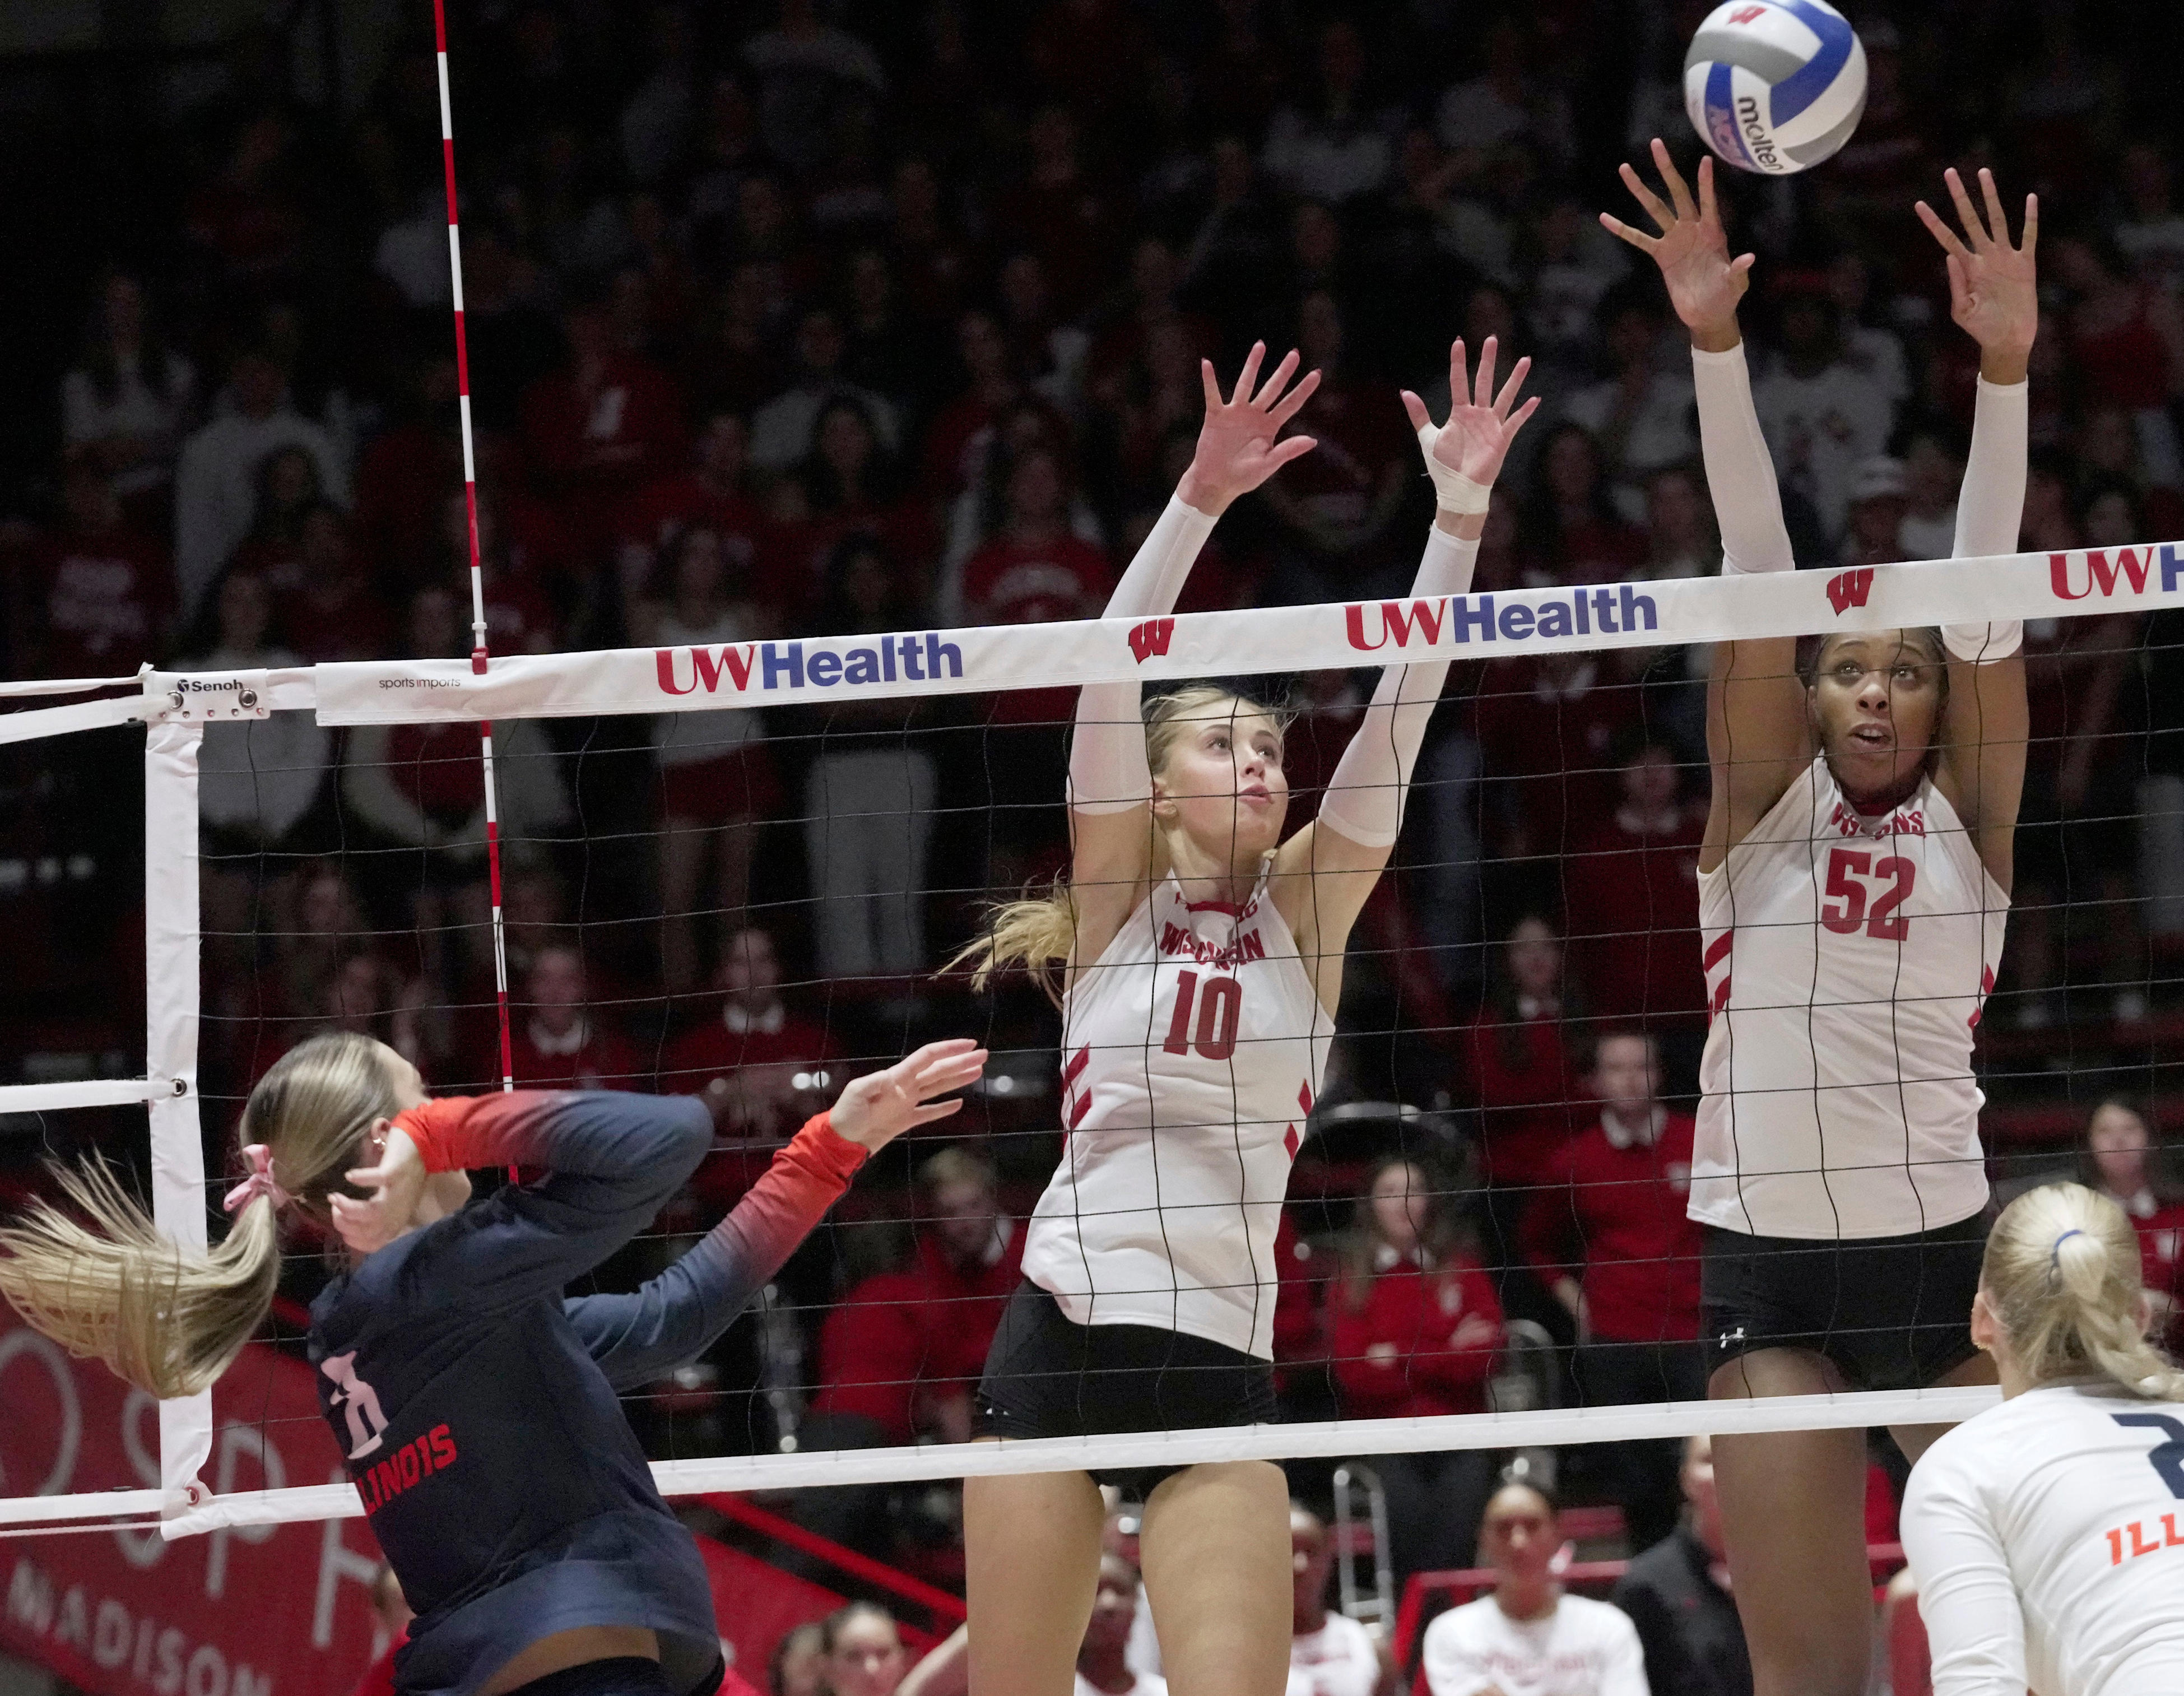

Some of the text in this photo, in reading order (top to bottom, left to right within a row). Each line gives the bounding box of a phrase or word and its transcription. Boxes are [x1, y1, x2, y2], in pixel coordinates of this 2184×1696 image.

[1738, 96, 1785, 171] molten
[191, 679, 243, 692] Senoh
[1821, 847, 1916, 942] 52
[1163, 969, 1242, 1061] 10
